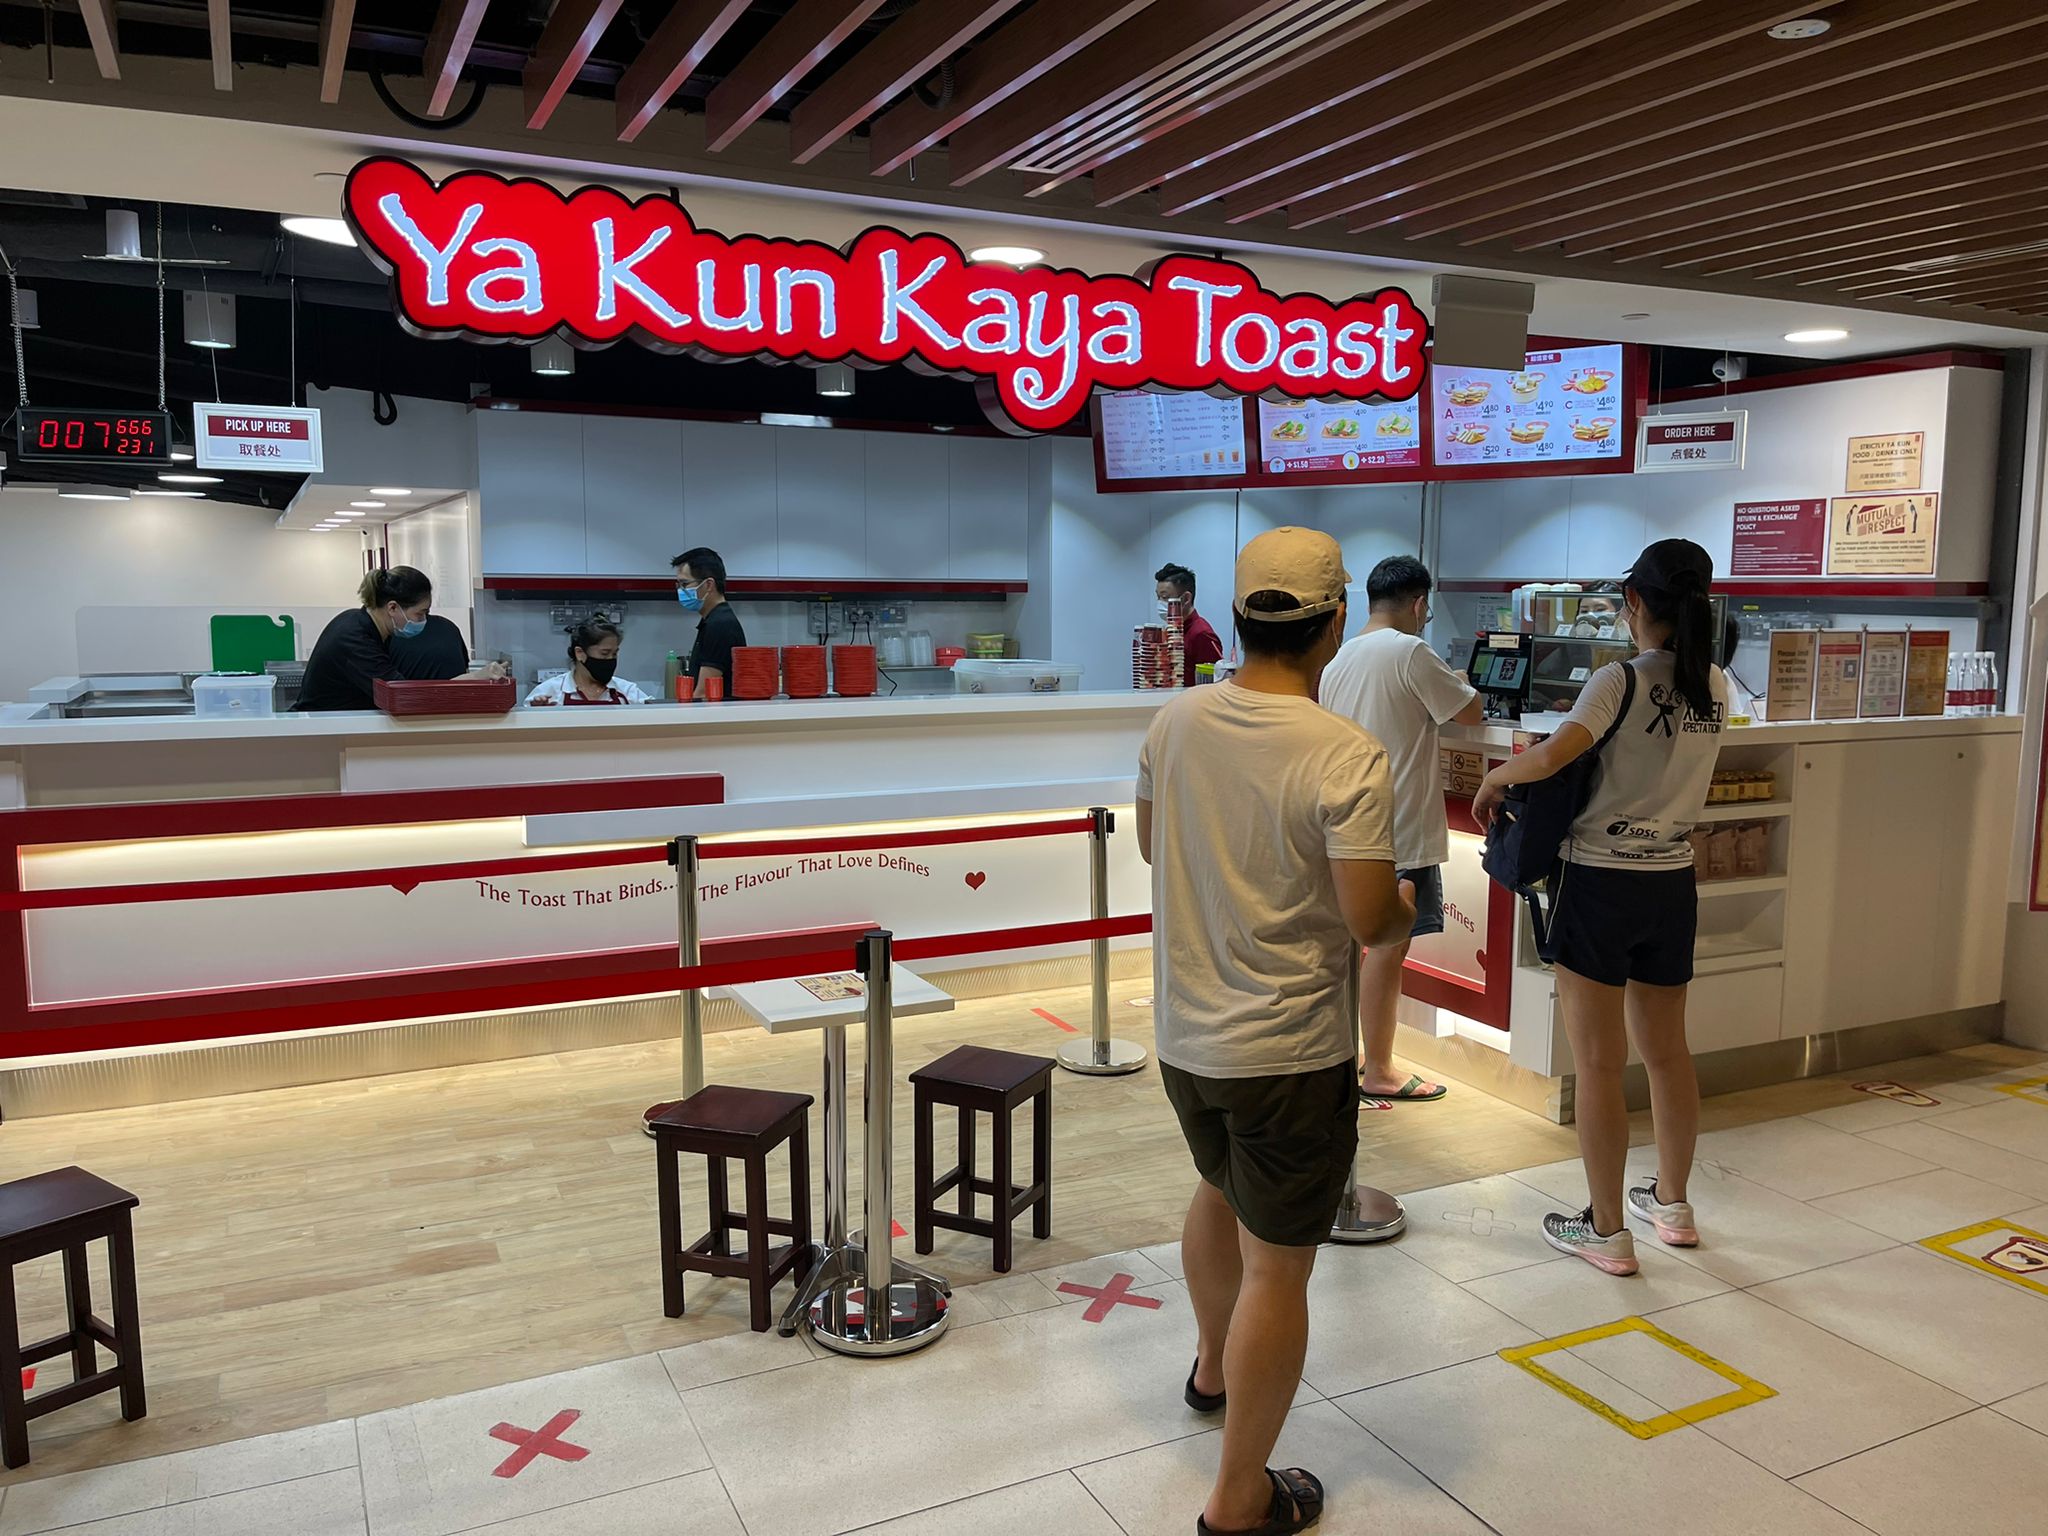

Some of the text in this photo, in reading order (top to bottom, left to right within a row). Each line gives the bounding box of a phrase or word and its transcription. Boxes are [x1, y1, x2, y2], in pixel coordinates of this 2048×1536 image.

[378, 192, 1414, 411] Ya Kun Kaya Toast
[1506, 405, 1511, 413] B
[1565, 400, 1573, 409] C
[1445, 408, 1454, 419] A
[116, 419, 152, 434] 666
[225, 419, 291, 433] PICK UP HERE
[1664, 425, 1716, 438] ORDER HERE
[39, 420, 110, 448] 007
[117, 439, 153, 454] 231
[239, 443, 281, 457] 取餐处
[1506, 448, 1511, 456] E
[1565, 445, 1570, 453] F
[1860, 442, 1885, 450] STRICTLY
[1670, 447, 1708, 460] 点餐处
[1853, 451, 1870, 459] FOOD
[1747, 505, 1779, 513] QUESTIONS
[1780, 504, 1800, 512] ASKED
[1763, 513, 1798, 521] EXCHANGE
[1856, 506, 1893, 525] MUTUAL
[1867, 514, 1907, 535] RESPECT
[1628, 826, 1659, 839] SDSC
[476, 880, 510, 903] The
[518, 889, 566, 907] Toast
[573, 890, 613, 906] That
[698, 882, 729, 902] The
[735, 865, 792, 891] Flavour
[798, 857, 832, 874] That
[838, 853, 873, 868] Love
[878, 853, 930, 877] Defines
[1443, 902, 1475, 933] efines
